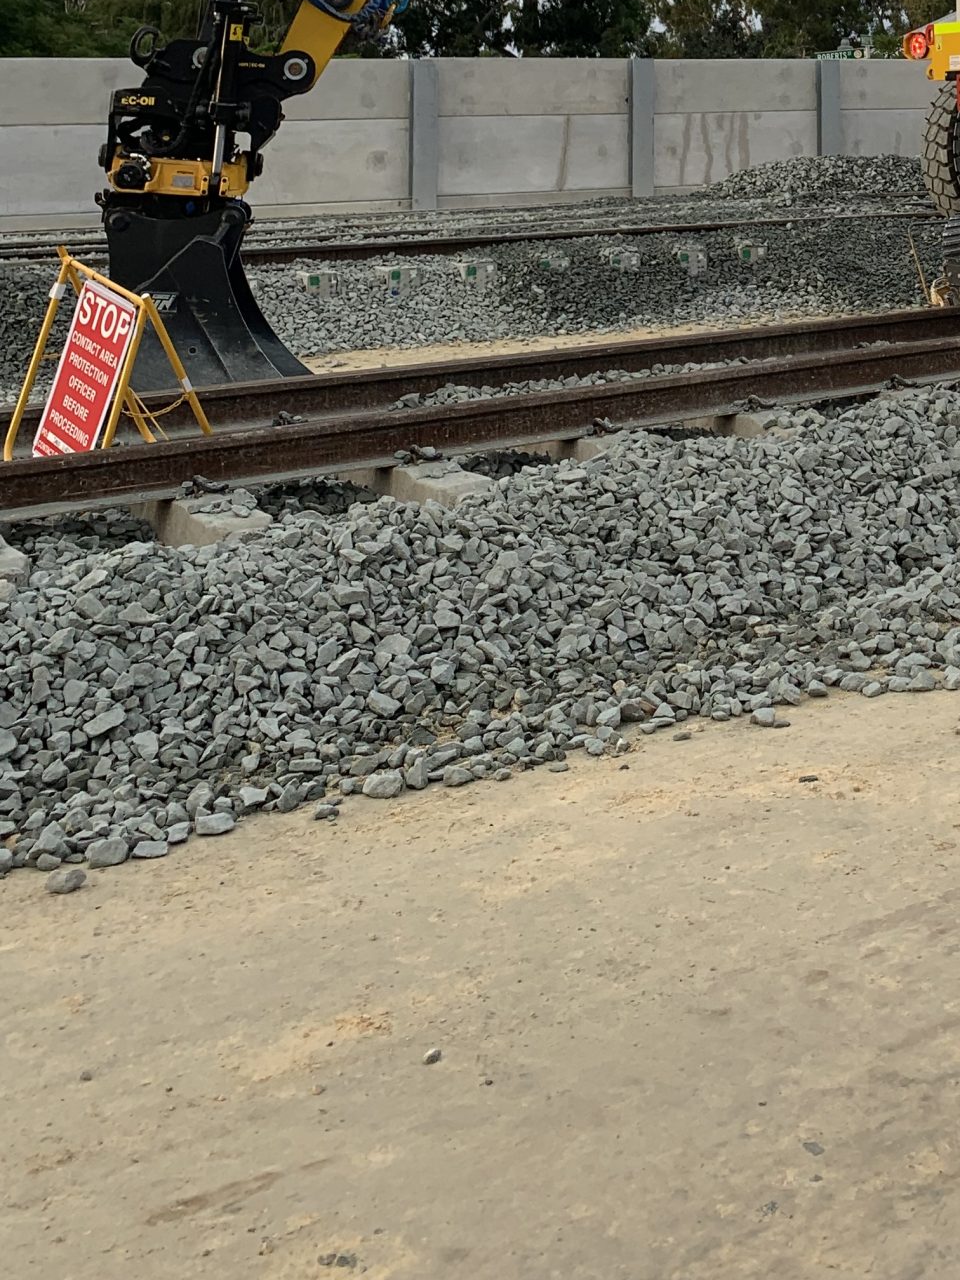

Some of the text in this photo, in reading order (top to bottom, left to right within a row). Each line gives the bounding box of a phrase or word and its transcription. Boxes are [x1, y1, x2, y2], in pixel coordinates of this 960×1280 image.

[78, 291, 131, 344] STOP
[68, 351, 110, 387] PROTECTION
[71, 330, 118, 370] CONTACT AREA
[68, 374, 97, 403] OFFICER
[62, 394, 90, 422] BEFORE
[49, 408, 90, 448] PROCEEDING
